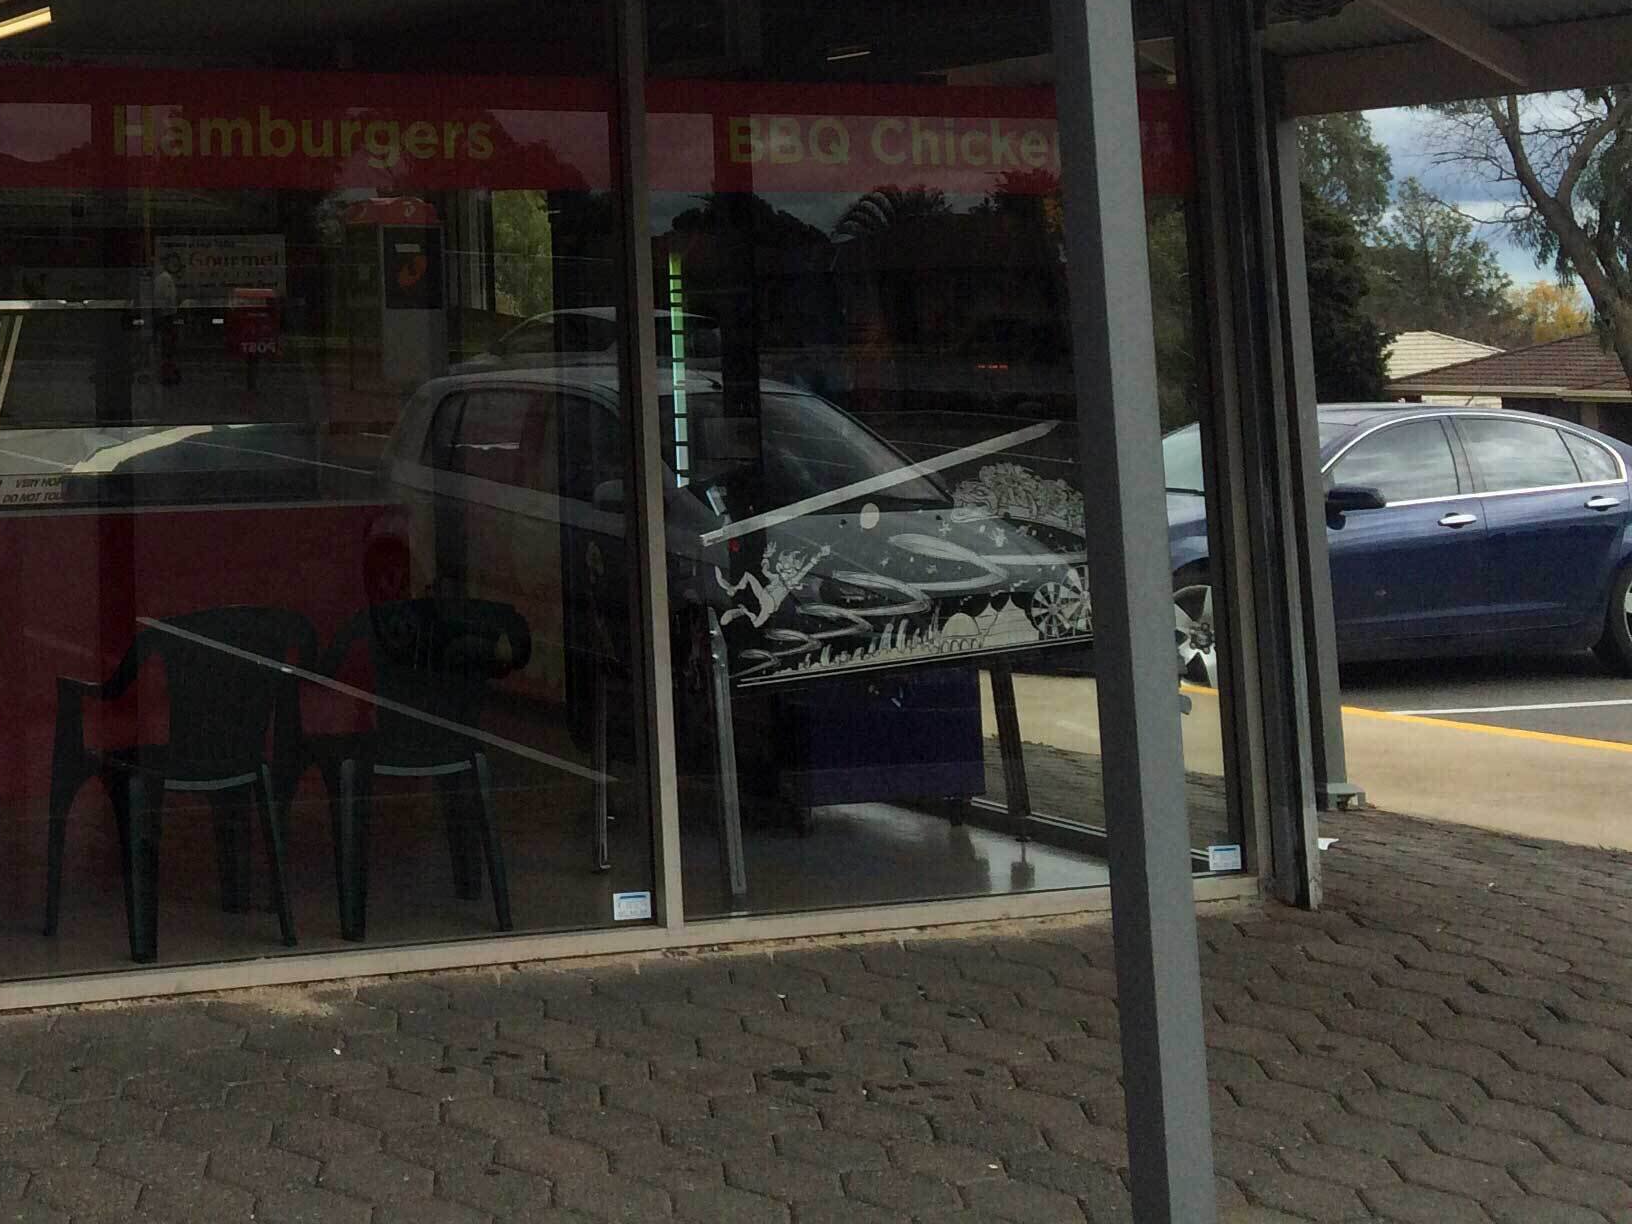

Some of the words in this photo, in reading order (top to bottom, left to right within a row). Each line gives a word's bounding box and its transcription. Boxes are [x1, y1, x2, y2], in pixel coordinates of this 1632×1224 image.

[112, 104, 496, 169] Hamburgers
[729, 117, 851, 166] BBQ
[871, 116, 1061, 168] Chicke
